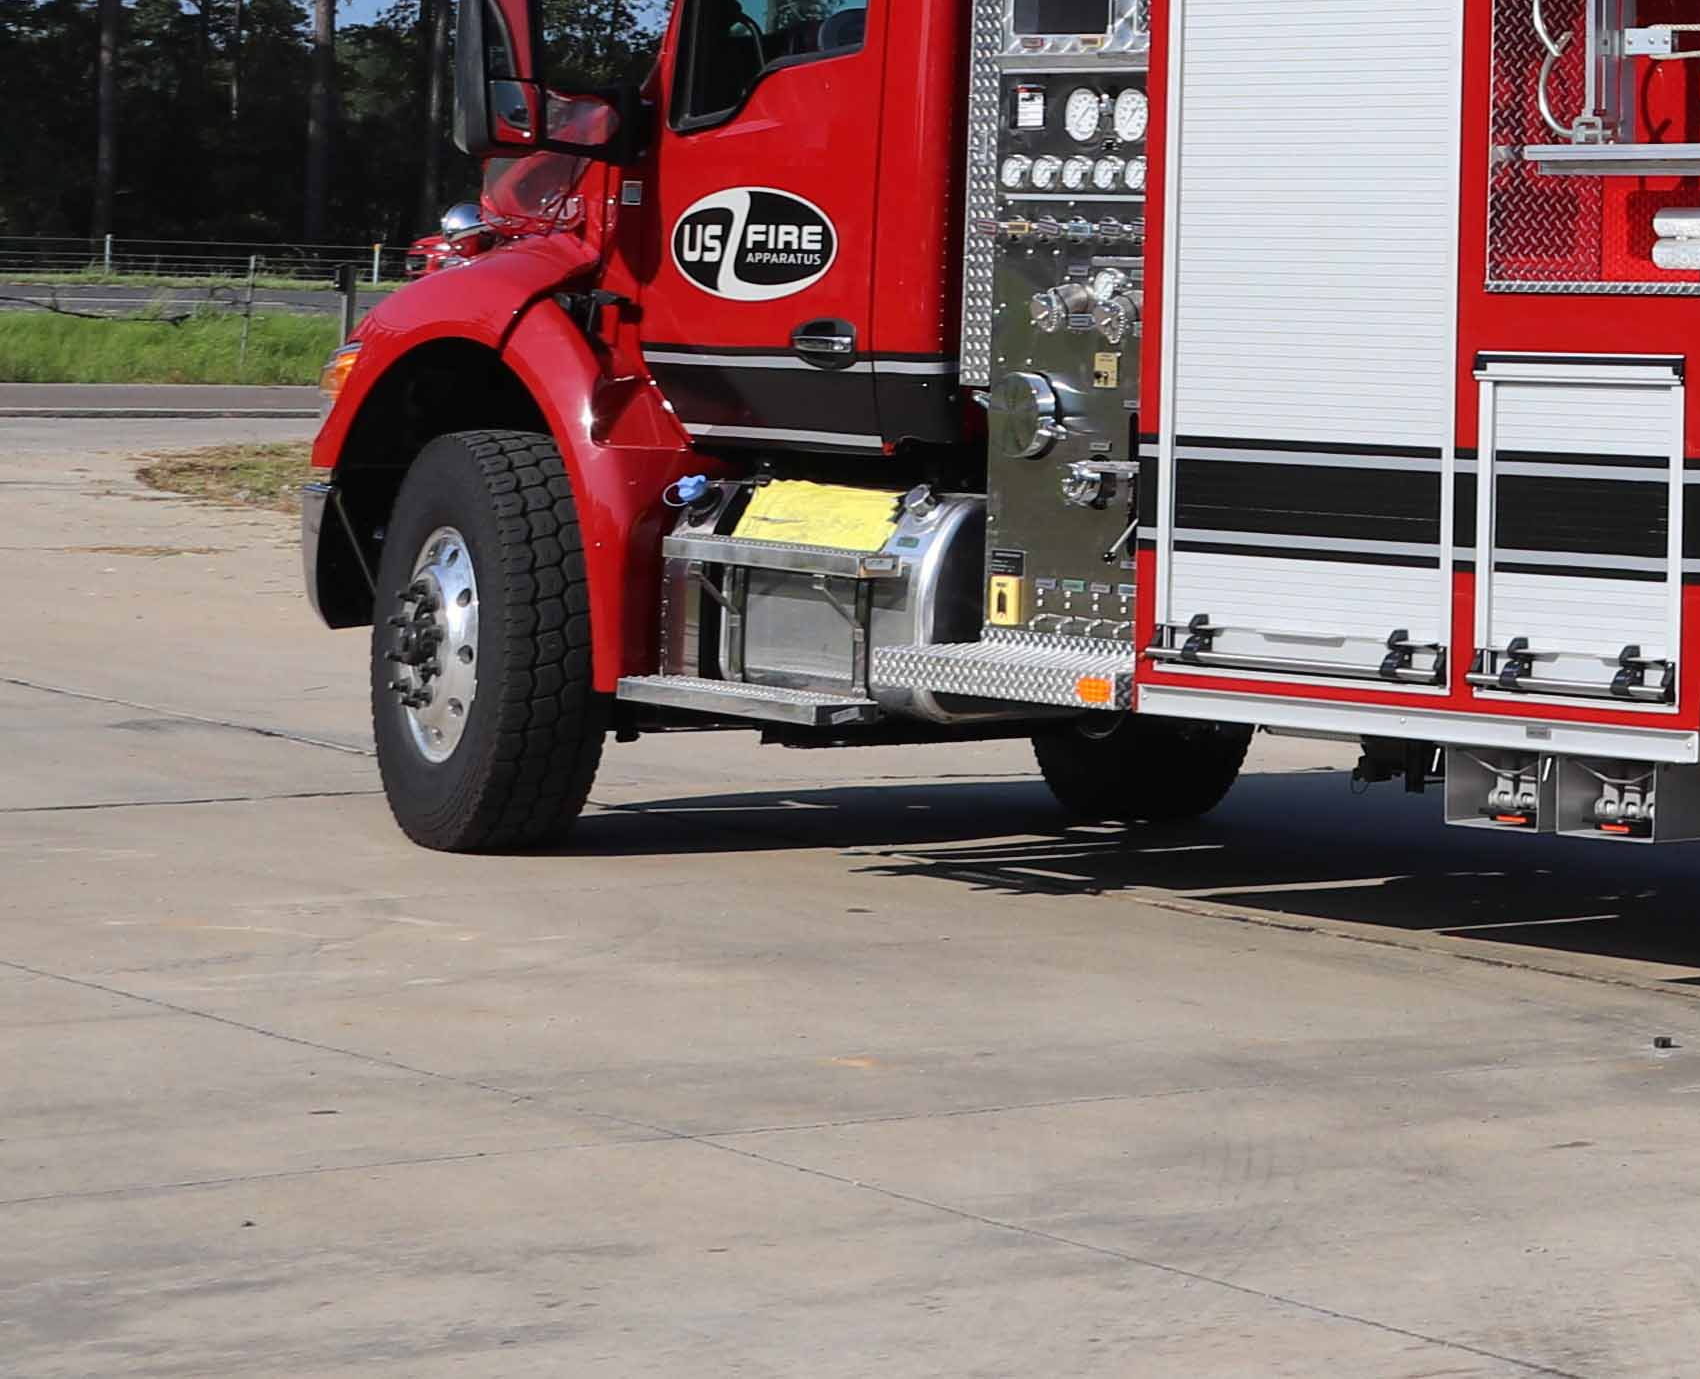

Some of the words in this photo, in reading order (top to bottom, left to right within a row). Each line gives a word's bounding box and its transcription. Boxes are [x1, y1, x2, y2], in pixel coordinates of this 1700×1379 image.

[683, 224, 722, 262] US
[746, 225, 822, 250] FIRE
[746, 252, 821, 264] APPARATUS
